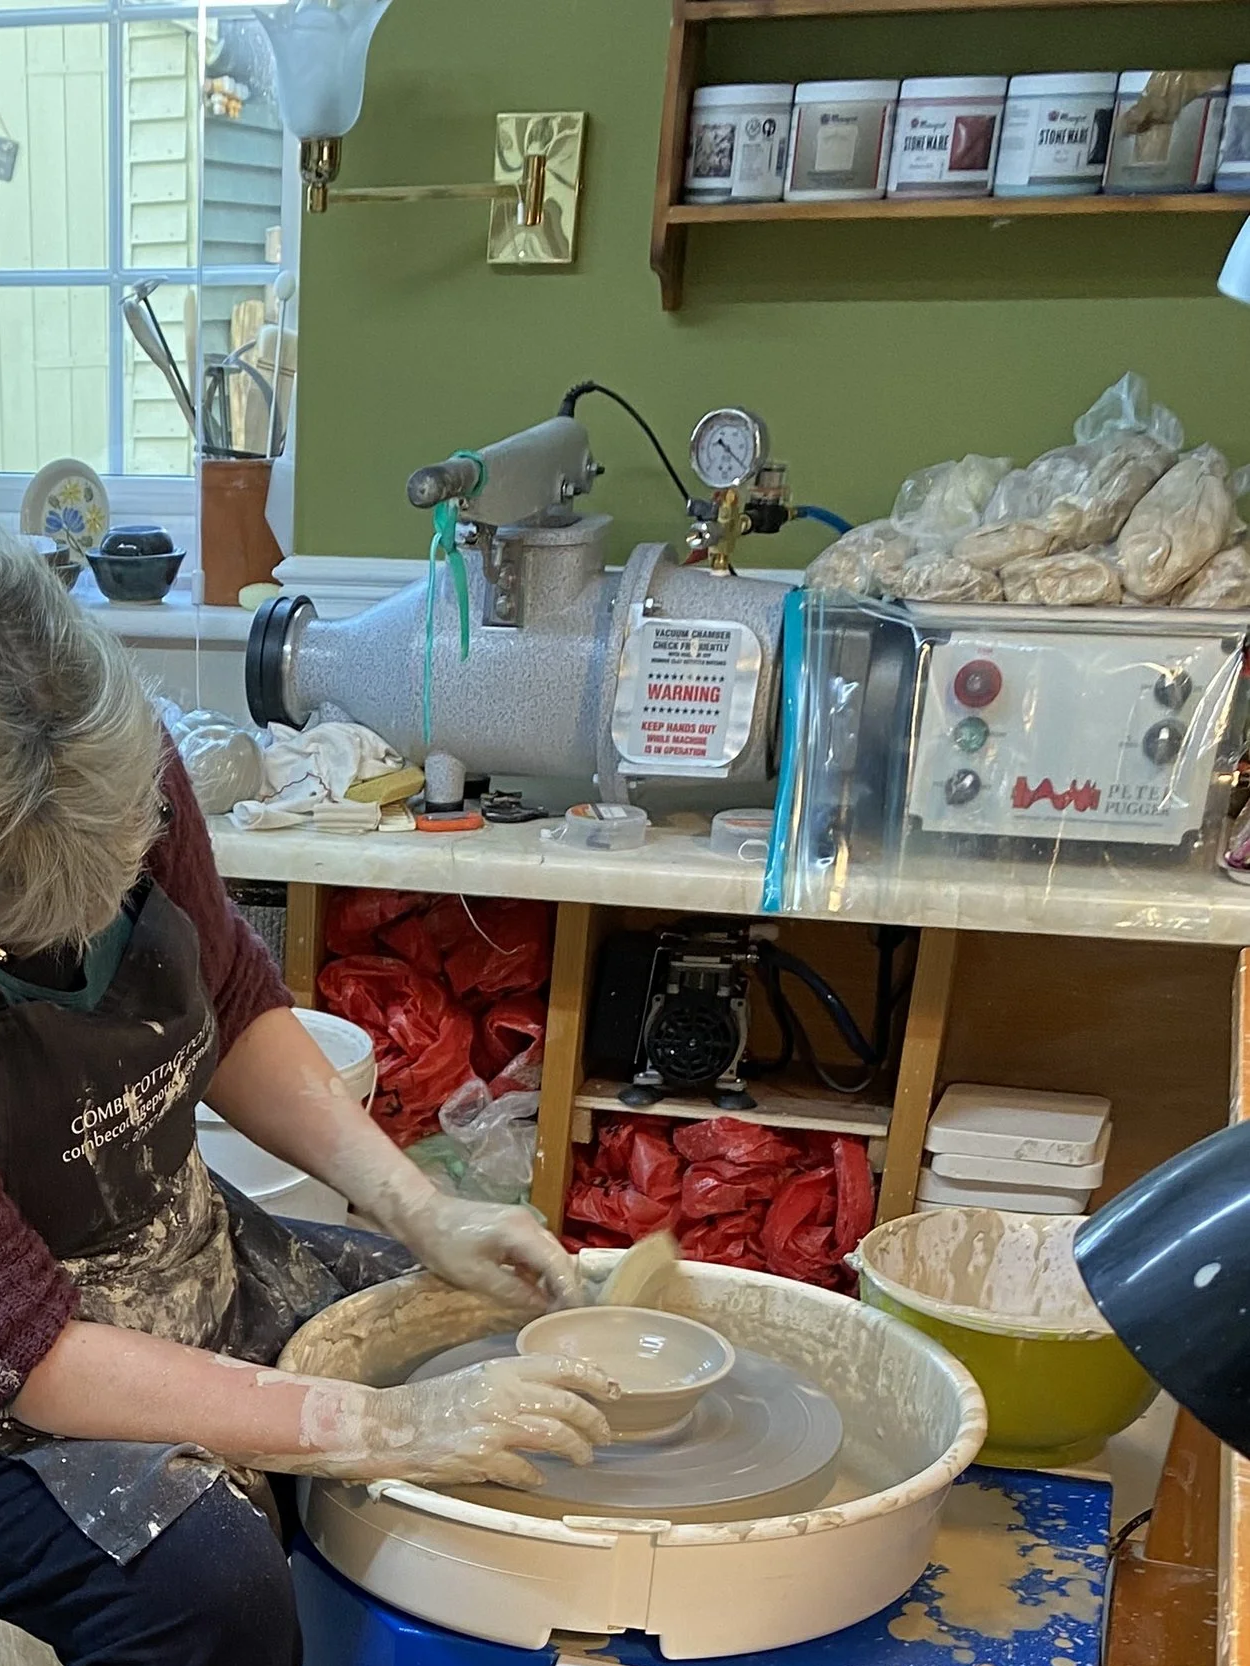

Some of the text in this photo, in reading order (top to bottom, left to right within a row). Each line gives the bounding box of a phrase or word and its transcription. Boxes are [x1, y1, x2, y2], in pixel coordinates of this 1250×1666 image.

[904, 134, 950, 152] STONEWARE
[1038, 127, 1089, 146] STONEWARE
[655, 629, 731, 640] VACUUM CHAMBER
[653, 641, 729, 652] CHECK FRUENTLY
[648, 683, 721, 703] WARNING
[641, 721, 717, 734] KEEP HANDS OUT
[647, 734, 707, 745] WHILE MACHINE
[644, 745, 707, 757] IS IN OPERATION
[133, 1045, 187, 1099] COTTAGE
